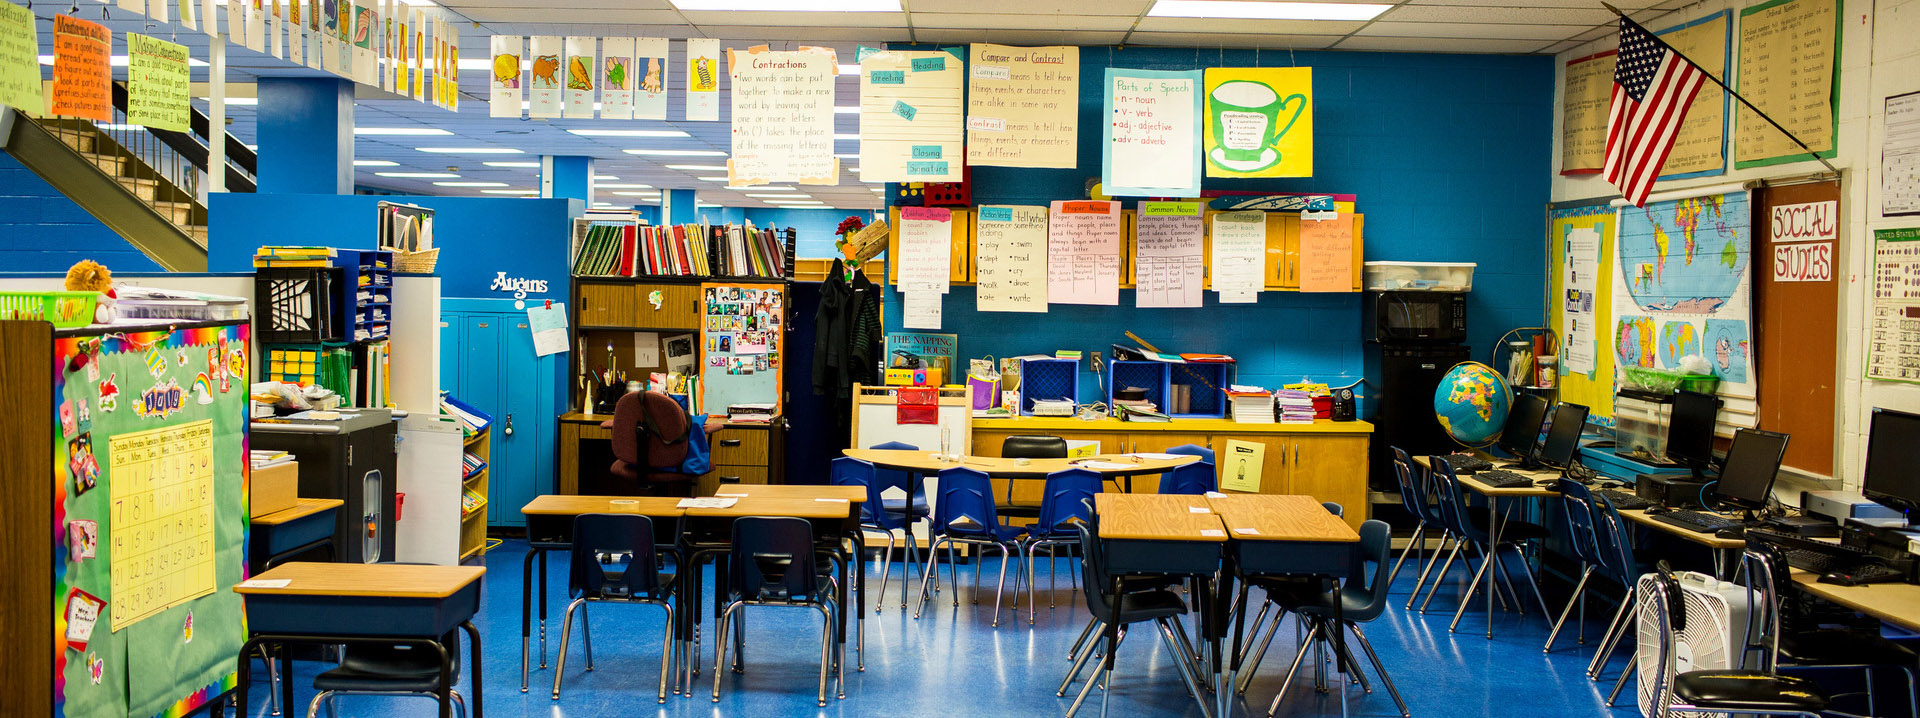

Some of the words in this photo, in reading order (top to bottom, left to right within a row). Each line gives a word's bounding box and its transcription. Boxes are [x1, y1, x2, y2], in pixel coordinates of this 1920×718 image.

[981, 50, 1010, 63] Compare
[1015, 52, 1028, 63] and
[1032, 52, 1065, 63] Contrast
[753, 59, 807, 70] Contractions
[913, 61, 944, 71] Heading
[739, 72, 752, 83] Two
[756, 74, 777, 83] words
[810, 73, 824, 84] put
[873, 73, 904, 84] Greeting
[1044, 72, 1055, 80] tell
[1059, 73, 1072, 82] how
[739, 88, 768, 100] together
[783, 88, 803, 96] make
[1027, 84, 1066, 95] characters
[1117, 80, 1138, 91] Parts
[1144, 82, 1154, 92] of
[1160, 80, 1190, 97] Speech
[739, 101, 757, 110] word
[762, 102, 771, 112] by
[804, 101, 817, 109] out
[988, 97, 1005, 108] alike
[1136, 97, 1157, 105] noun
[895, 104, 913, 120] Body
[1136, 106, 1153, 118] verb
[970, 119, 1002, 129] Contrast
[1119, 119, 1131, 134] adj
[1138, 120, 1173, 135] adjective
[1118, 135, 1132, 144] adv
[1140, 135, 1167, 145] adverb
[913, 147, 941, 159] Closing
[987, 147, 1022, 158] different
[910, 164, 948, 174] Signature
[1147, 205, 1174, 213] Common
[1176, 205, 1196, 213] Nouns
[1053, 213, 1071, 222] Proper
[1138, 214, 1165, 223] Common
[1773, 204, 1834, 239] SOCIAL
[986, 242, 1000, 251] play
[984, 255, 999, 264] slept
[1014, 254, 1030, 262] read
[1776, 245, 1830, 281] STUDIES
[983, 268, 995, 276] run
[1013, 268, 1024, 277] cry
[1013, 293, 1031, 303] write
[892, 335, 911, 344] THE
[914, 336, 952, 347] NAPPING
[923, 346, 952, 355] HOUSE
[116, 501, 123, 523] 7
[133, 496, 141, 520] 8
